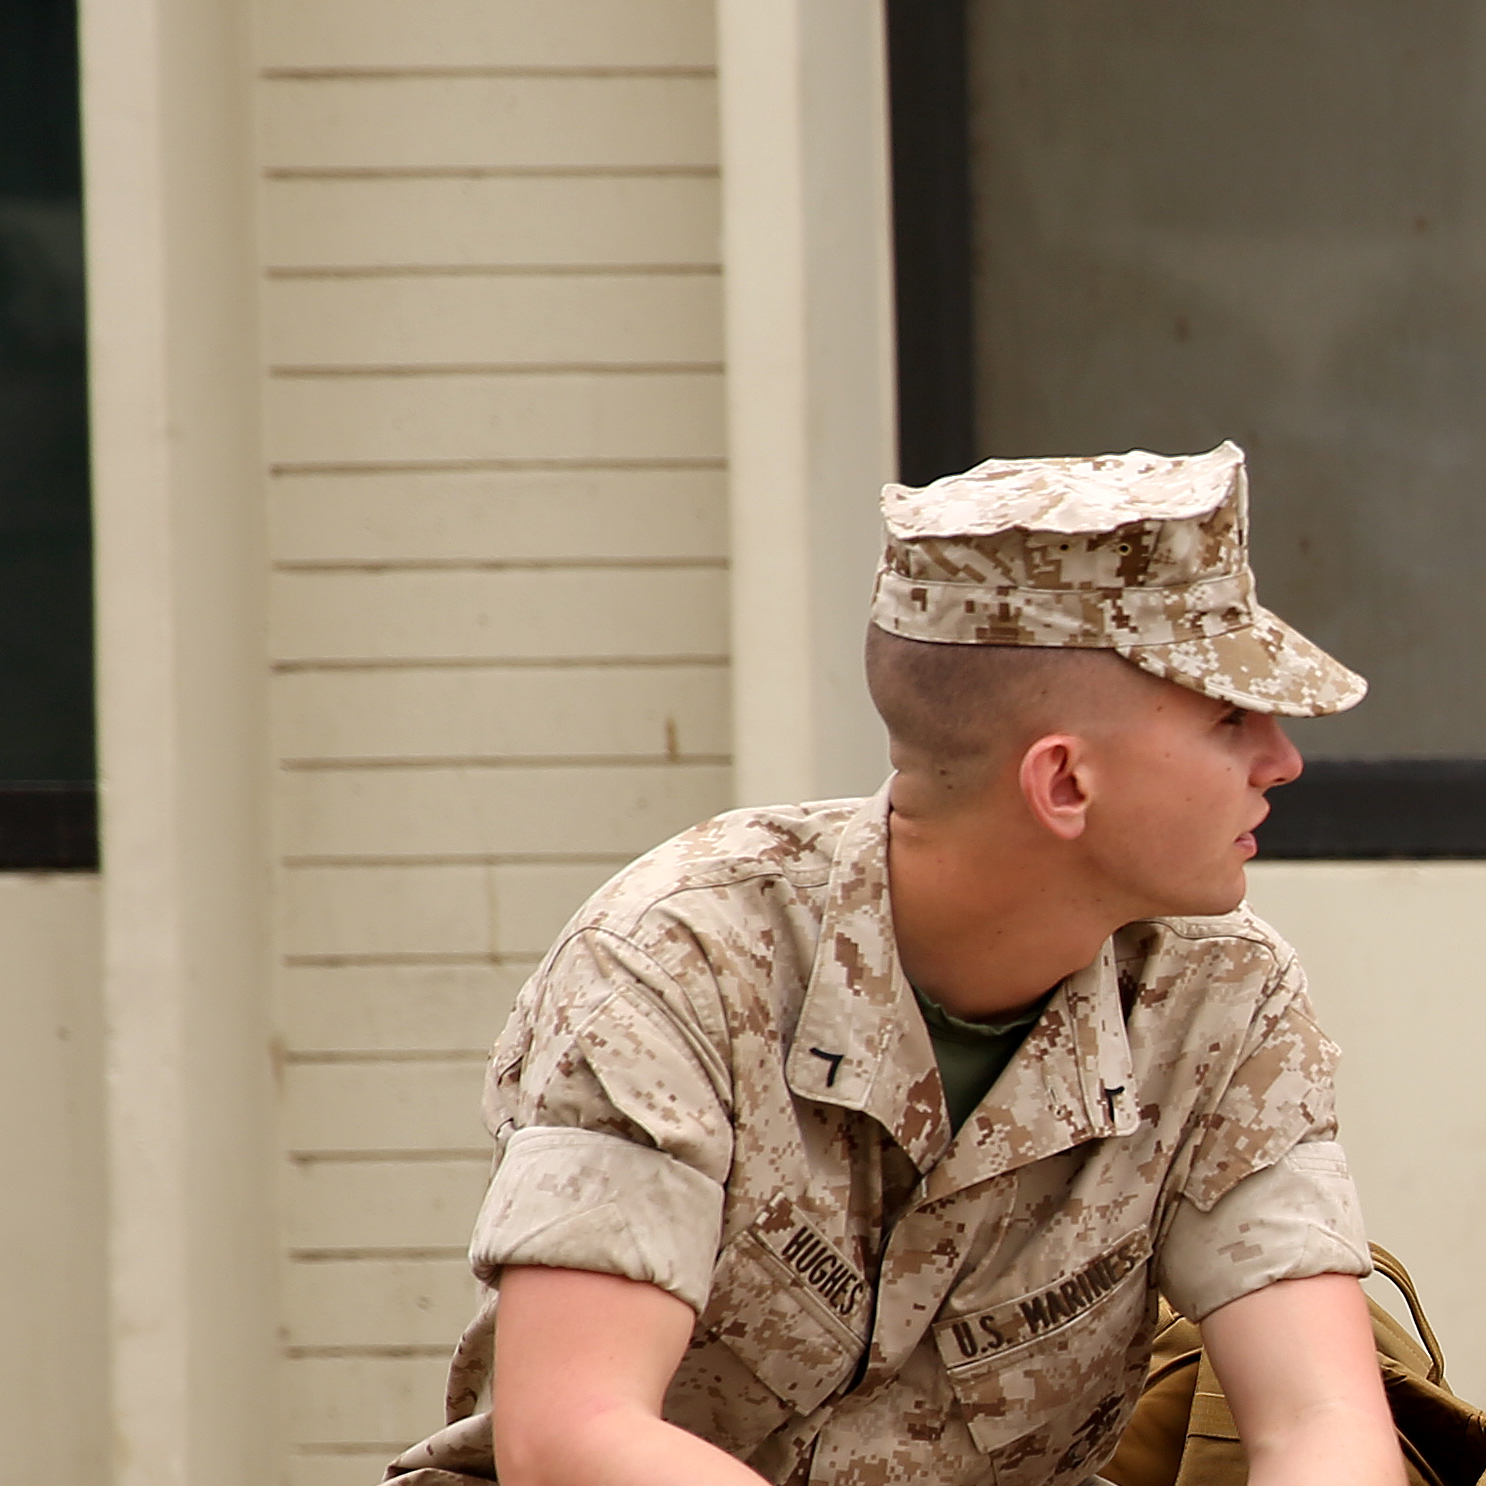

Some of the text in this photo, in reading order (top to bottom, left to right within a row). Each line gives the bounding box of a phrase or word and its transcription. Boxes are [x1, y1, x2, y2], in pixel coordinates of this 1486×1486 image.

[782, 1226, 864, 1315] HUGHES
[952, 1245, 1135, 1358] U.S. MARINES
